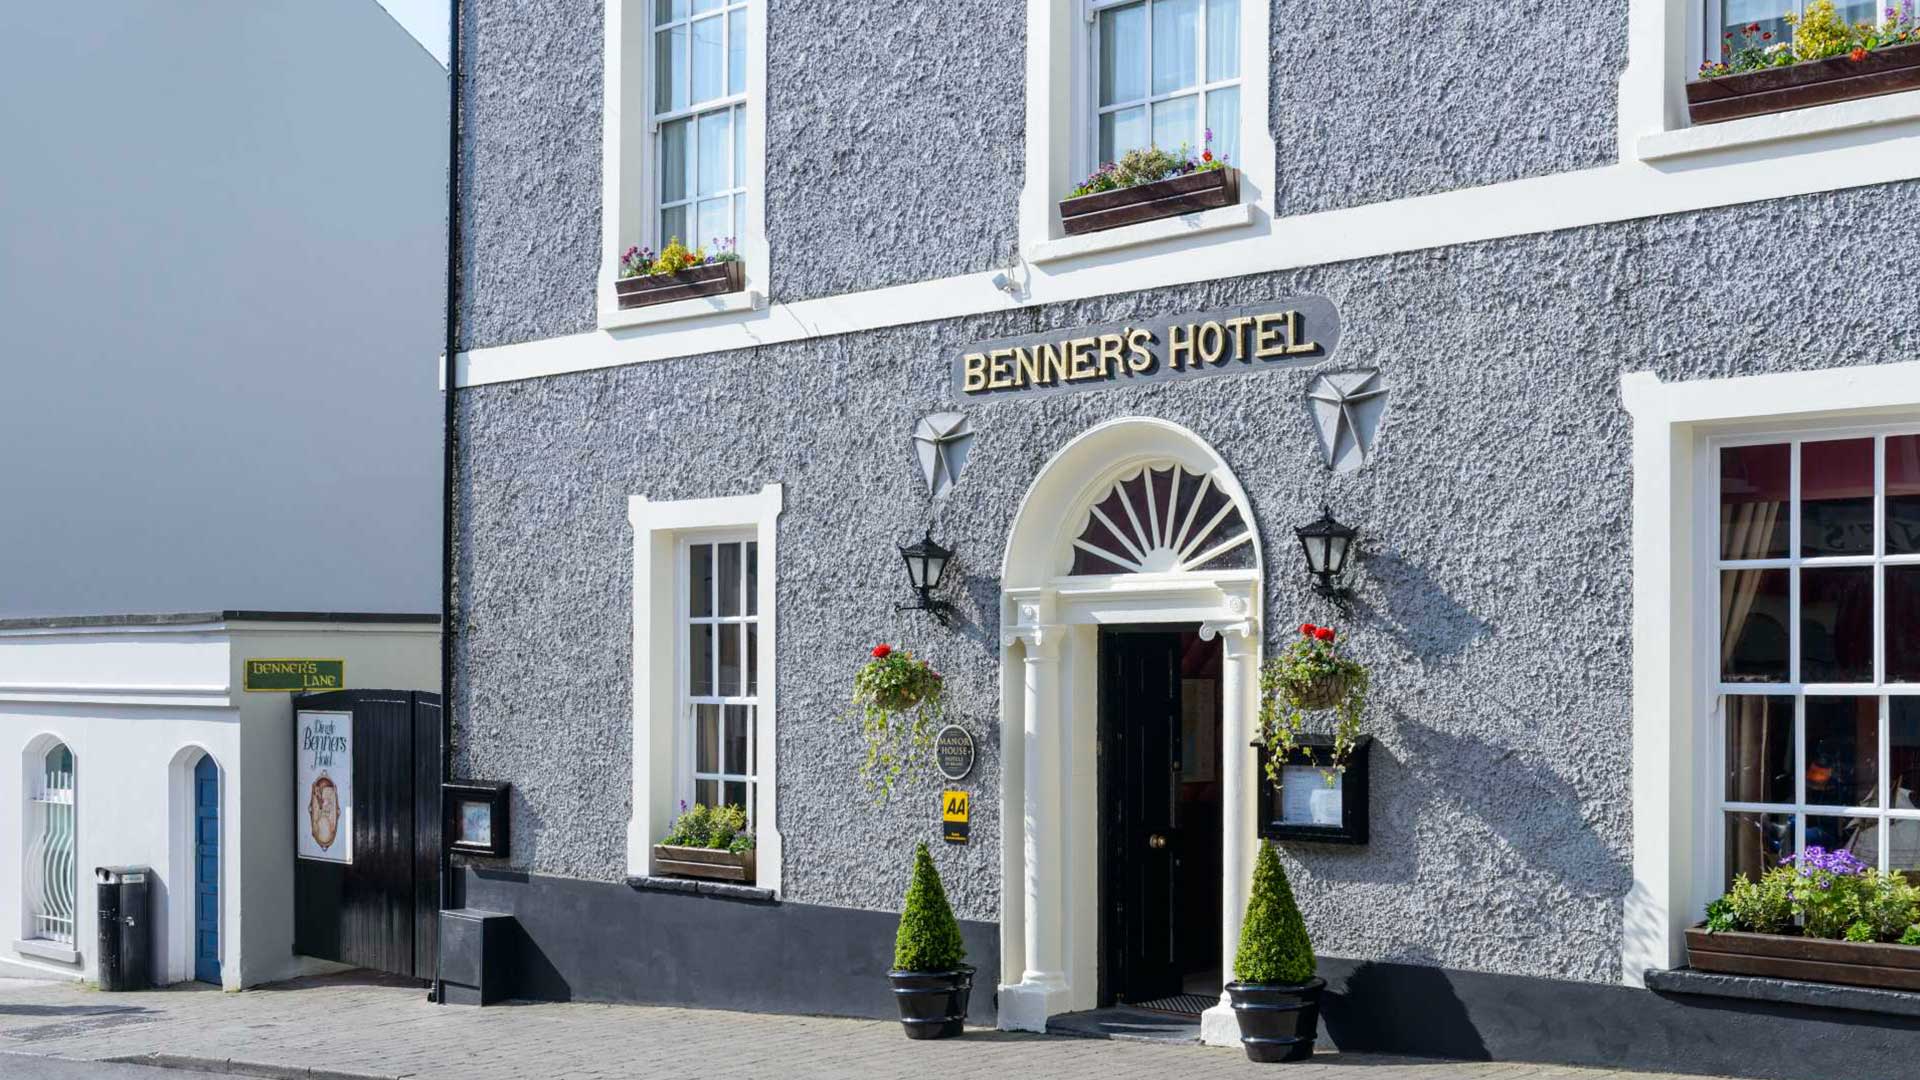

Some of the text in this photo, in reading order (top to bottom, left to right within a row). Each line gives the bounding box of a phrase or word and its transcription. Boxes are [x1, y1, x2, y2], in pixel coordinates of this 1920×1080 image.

[963, 310, 1317, 392] BENNER'S HOTEL
[253, 661, 318, 674] BENNER'S
[303, 674, 336, 687] LANE
[303, 726, 347, 752] Benners
[938, 736, 970, 746] MANOR
[941, 746, 968, 755] HOUSE
[946, 797, 966, 815] AA
